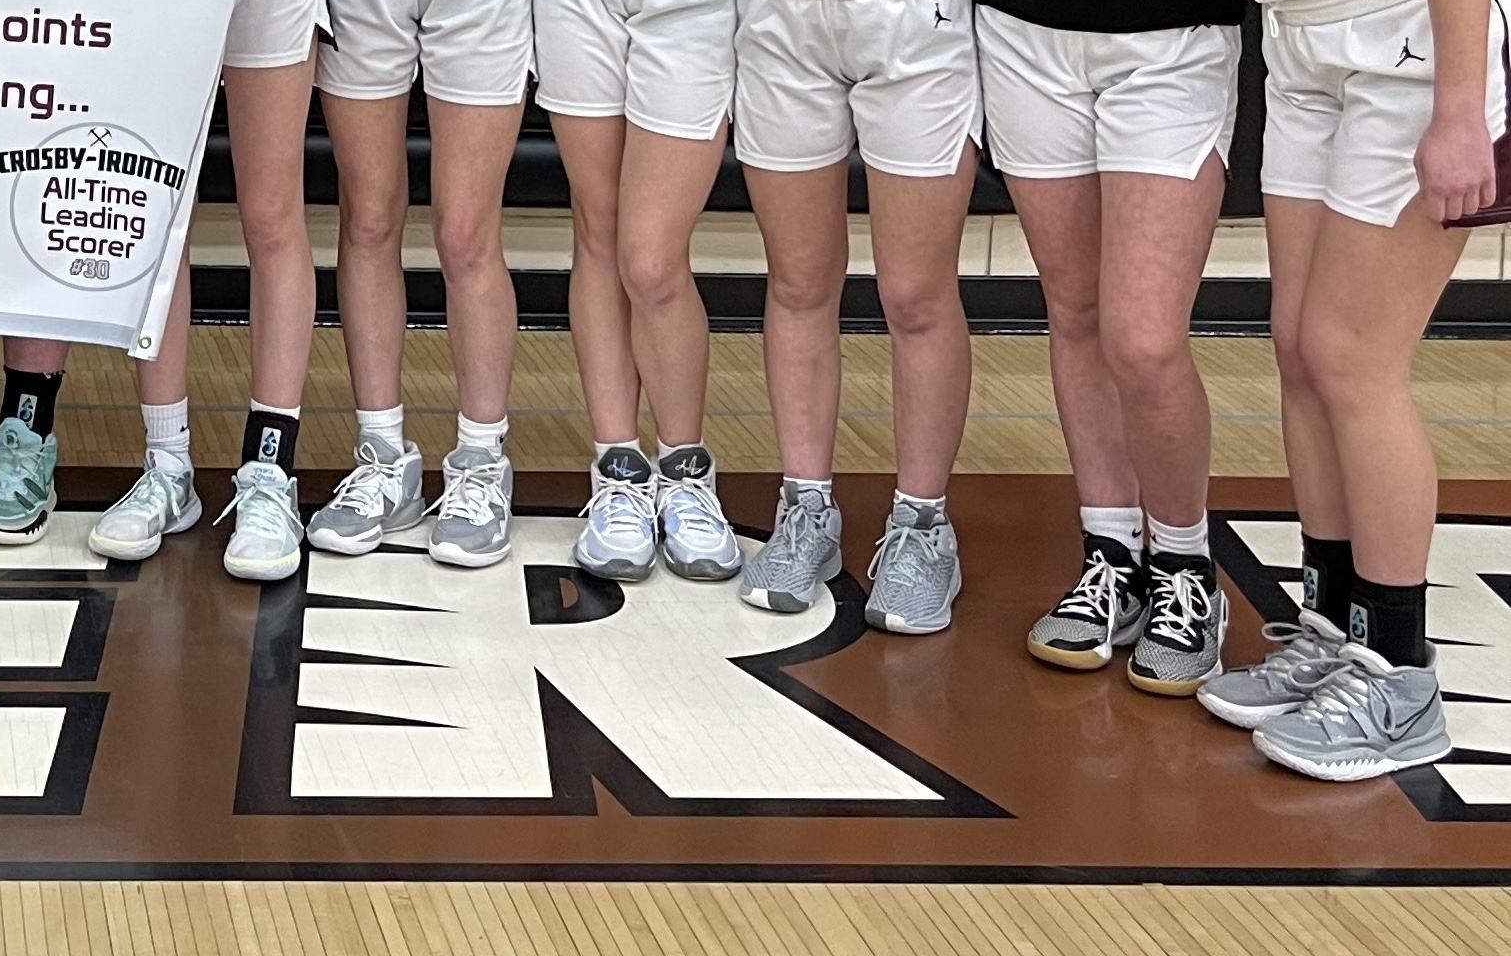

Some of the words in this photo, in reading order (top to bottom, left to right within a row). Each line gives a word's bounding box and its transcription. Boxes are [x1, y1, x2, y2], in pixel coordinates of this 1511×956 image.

[42, 176, 148, 208] All-Time
[40, 201, 146, 240] Leading
[47, 229, 136, 259] Scorer
[69, 258, 110, 280] #30
